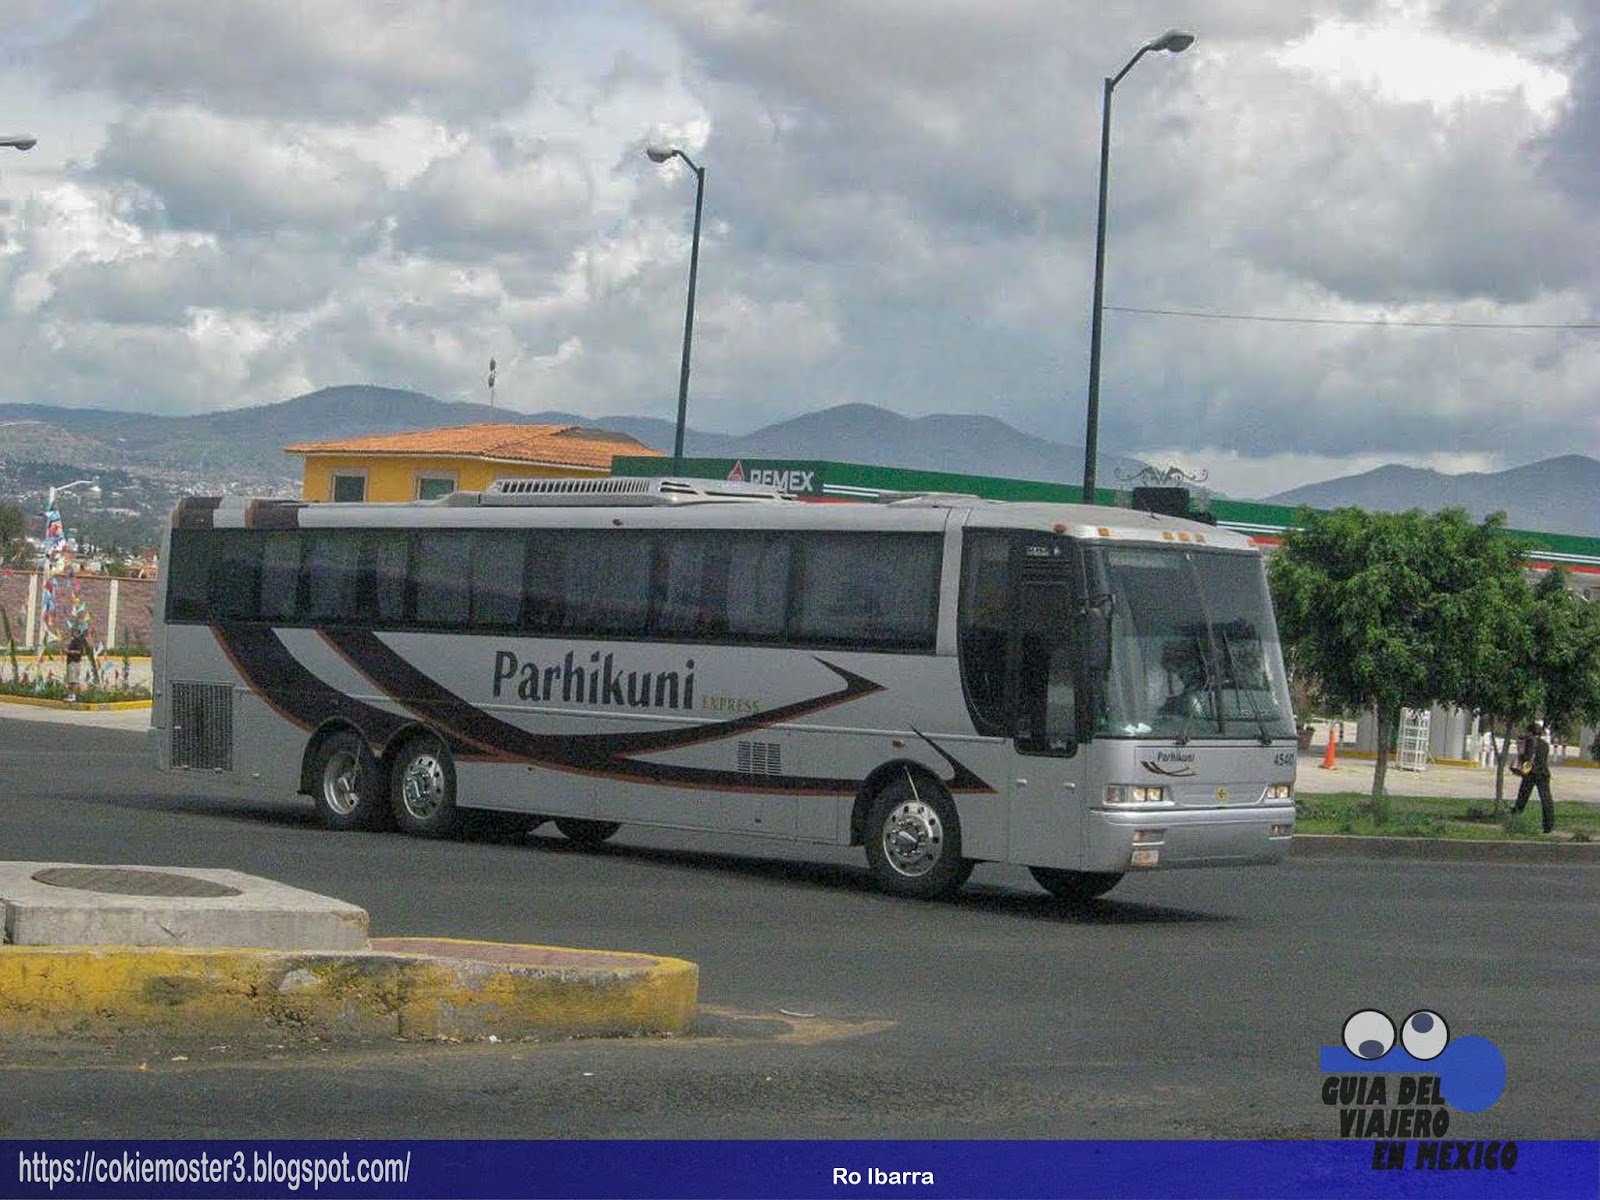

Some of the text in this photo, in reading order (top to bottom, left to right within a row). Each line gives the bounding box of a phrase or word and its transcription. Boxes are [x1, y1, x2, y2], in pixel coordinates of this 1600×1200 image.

[749, 469, 814, 493] PEMEX
[493, 649, 695, 710] Parhikuni
[1157, 751, 1195, 763] Parhikuni
